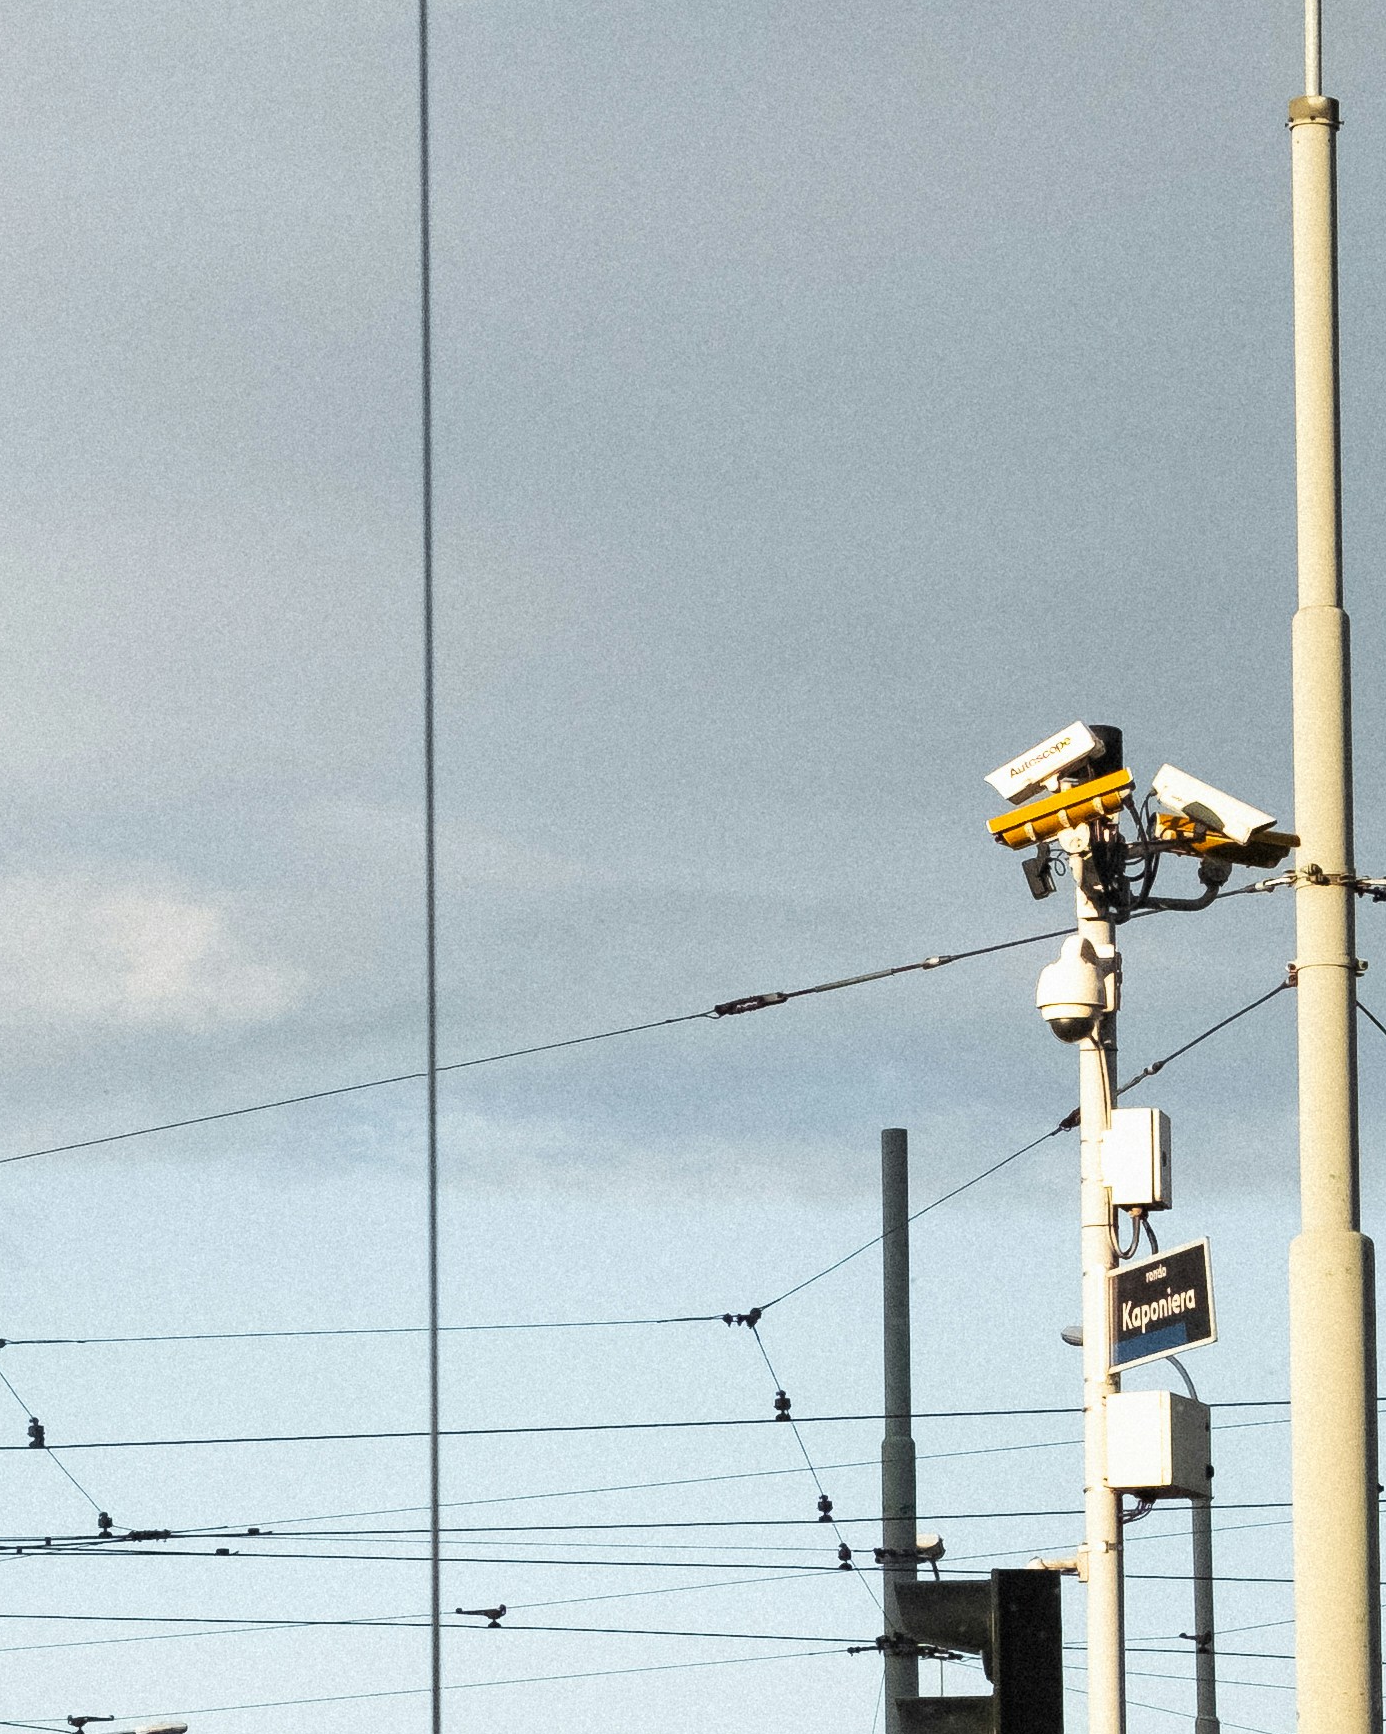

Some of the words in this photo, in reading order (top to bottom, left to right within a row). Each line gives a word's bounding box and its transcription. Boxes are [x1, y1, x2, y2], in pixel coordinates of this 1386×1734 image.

[1009, 737, 1071, 778] Autoscope
[1145, 1263, 1167, 1283] rondo
[1122, 1287, 1196, 1334] Kaponiera
